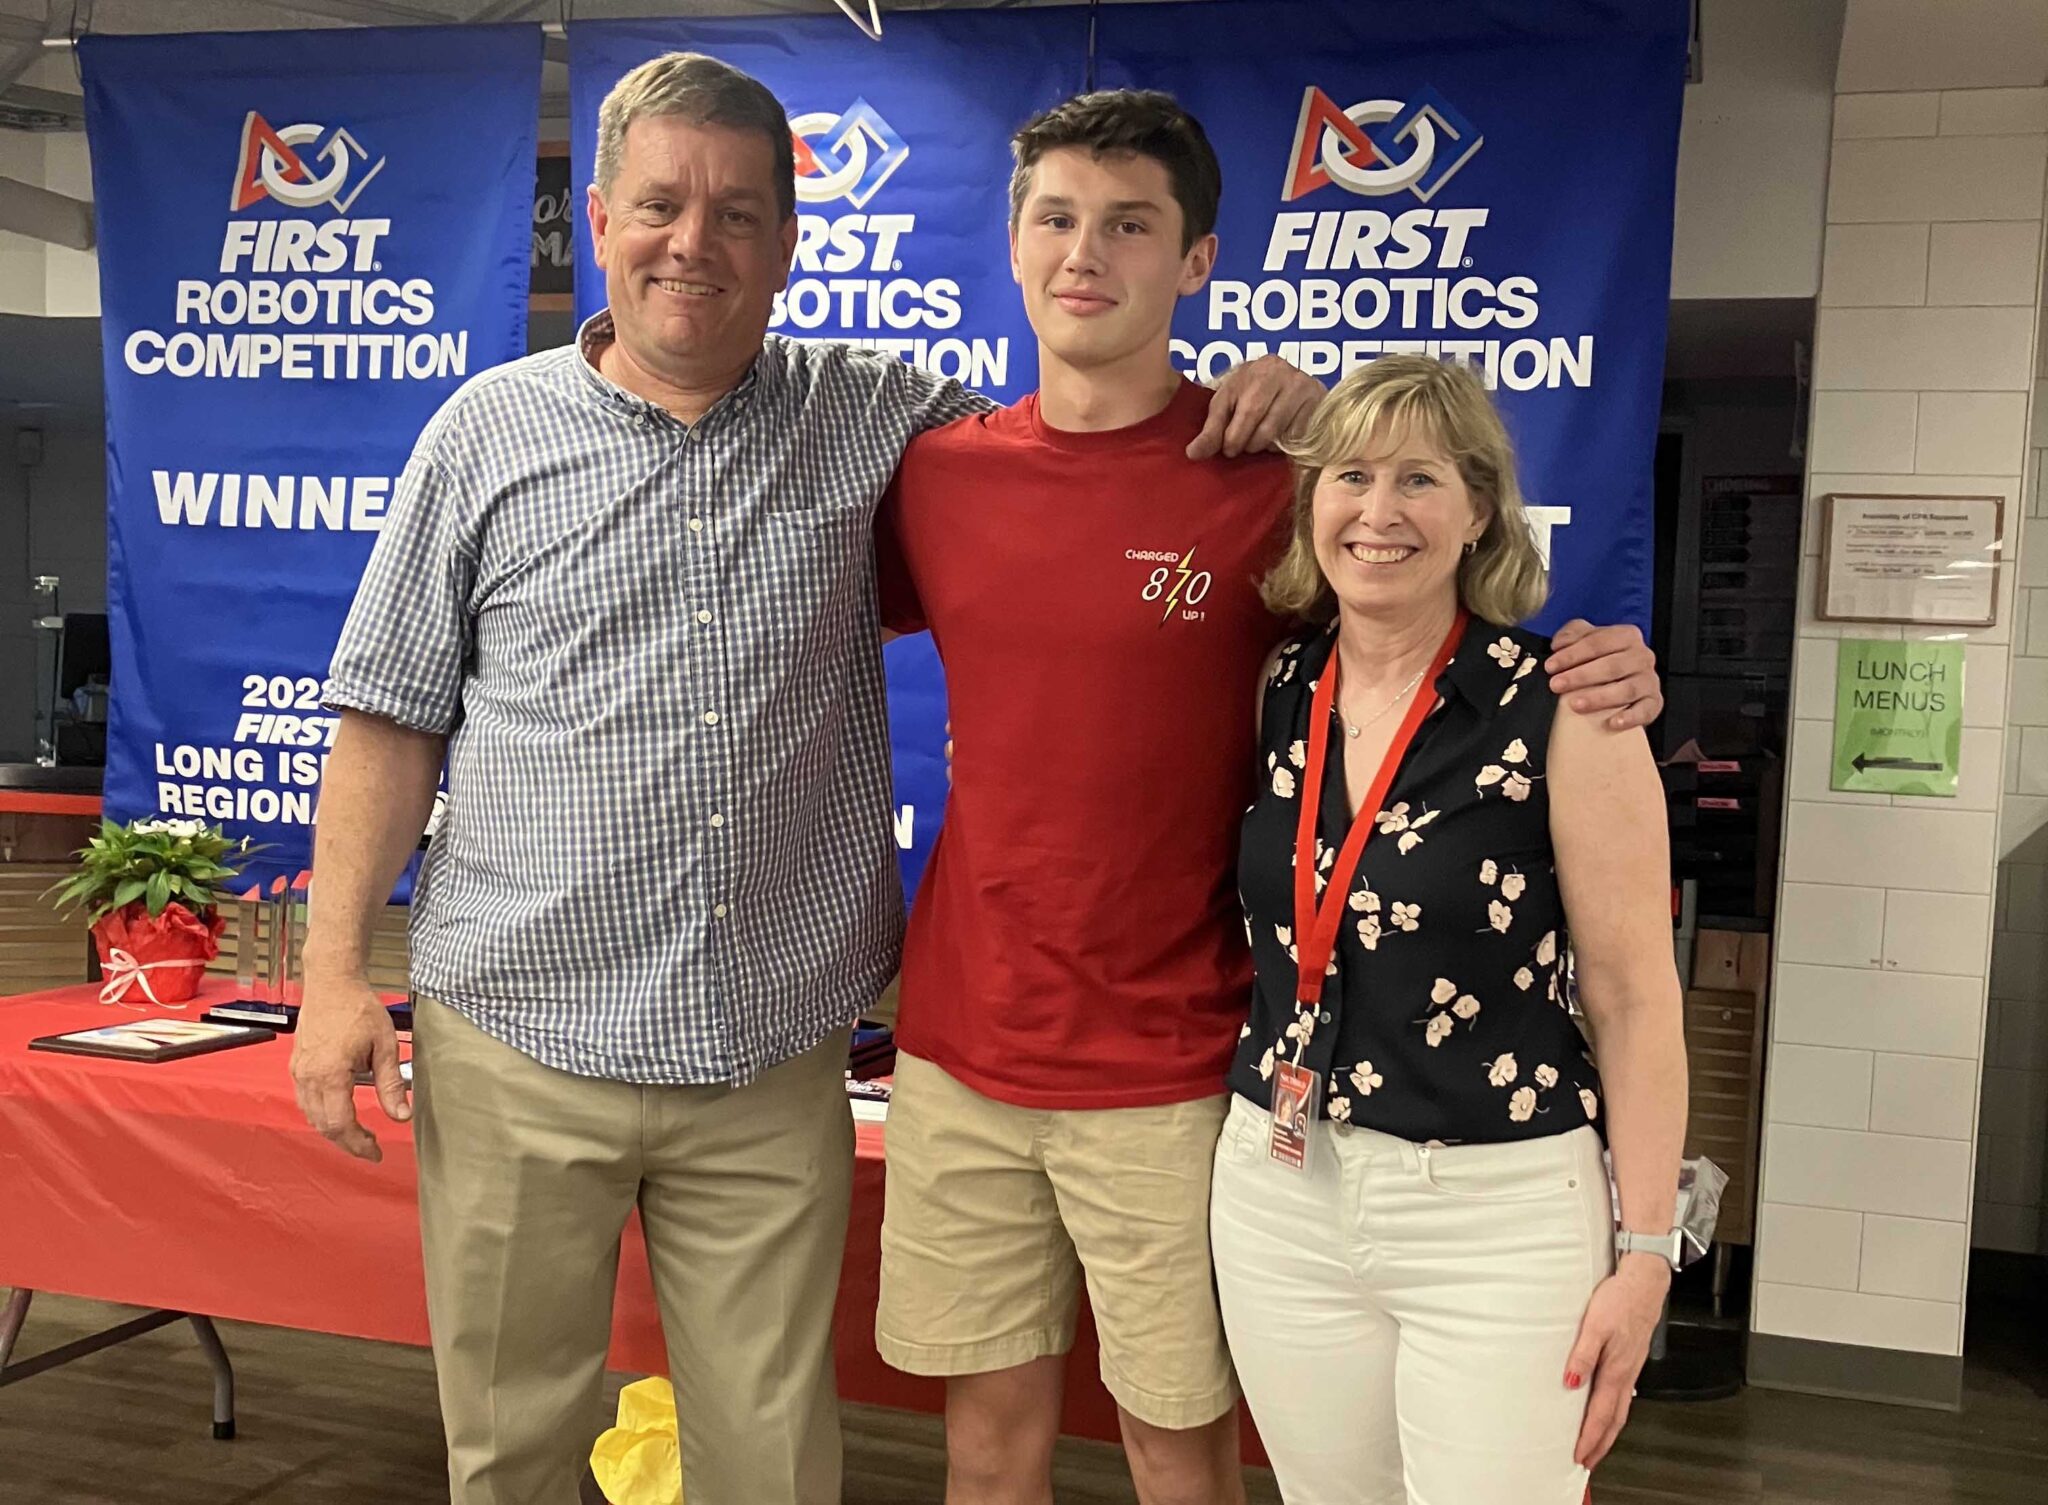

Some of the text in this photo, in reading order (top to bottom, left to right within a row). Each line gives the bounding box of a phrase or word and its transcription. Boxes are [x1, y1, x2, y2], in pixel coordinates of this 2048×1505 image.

[219, 218, 391, 273] FIRST
[791, 214, 915, 273] RST
[1263, 208, 1490, 271] FIRST
[176, 279, 434, 325] ROBOTICS
[767, 278, 961, 330] BOTICS
[1208, 276, 1540, 332] ROBOTICS
[124, 330, 468, 379] COMPETITION
[152, 470, 402, 531] WINNE
[1125, 549, 1180, 563] CHARGED
[242, 674, 340, 712] 202
[1857, 660, 1946, 683] LUNCH
[1853, 690, 1946, 712] MENUS
[155, 742, 264, 782] LONG
[158, 781, 319, 825] REGION
